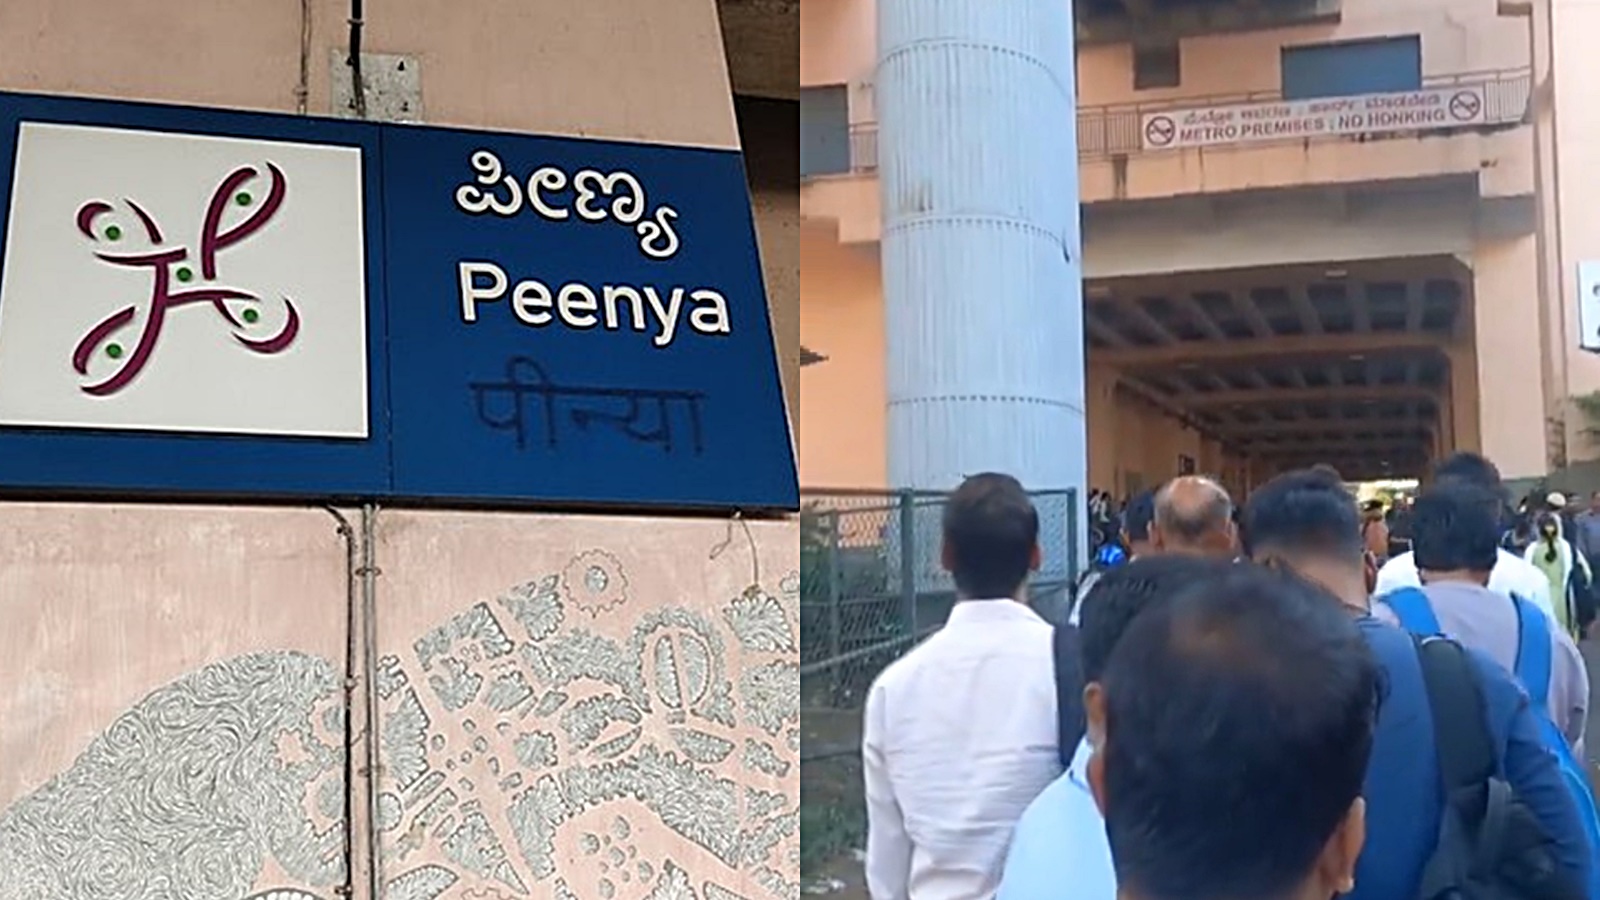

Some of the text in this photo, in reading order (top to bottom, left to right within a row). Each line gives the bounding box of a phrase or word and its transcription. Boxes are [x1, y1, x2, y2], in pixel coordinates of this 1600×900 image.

[1180, 125, 1237, 142] METRO
[1241, 117, 1325, 137] PREMISES
[1338, 113, 1363, 130] NO
[1368, 109, 1446, 128] HONKING
[455, 149, 680, 258] ಪೀಣ್ಯ
[458, 261, 732, 347] Peenya
[468, 354, 708, 454] पीन्या
